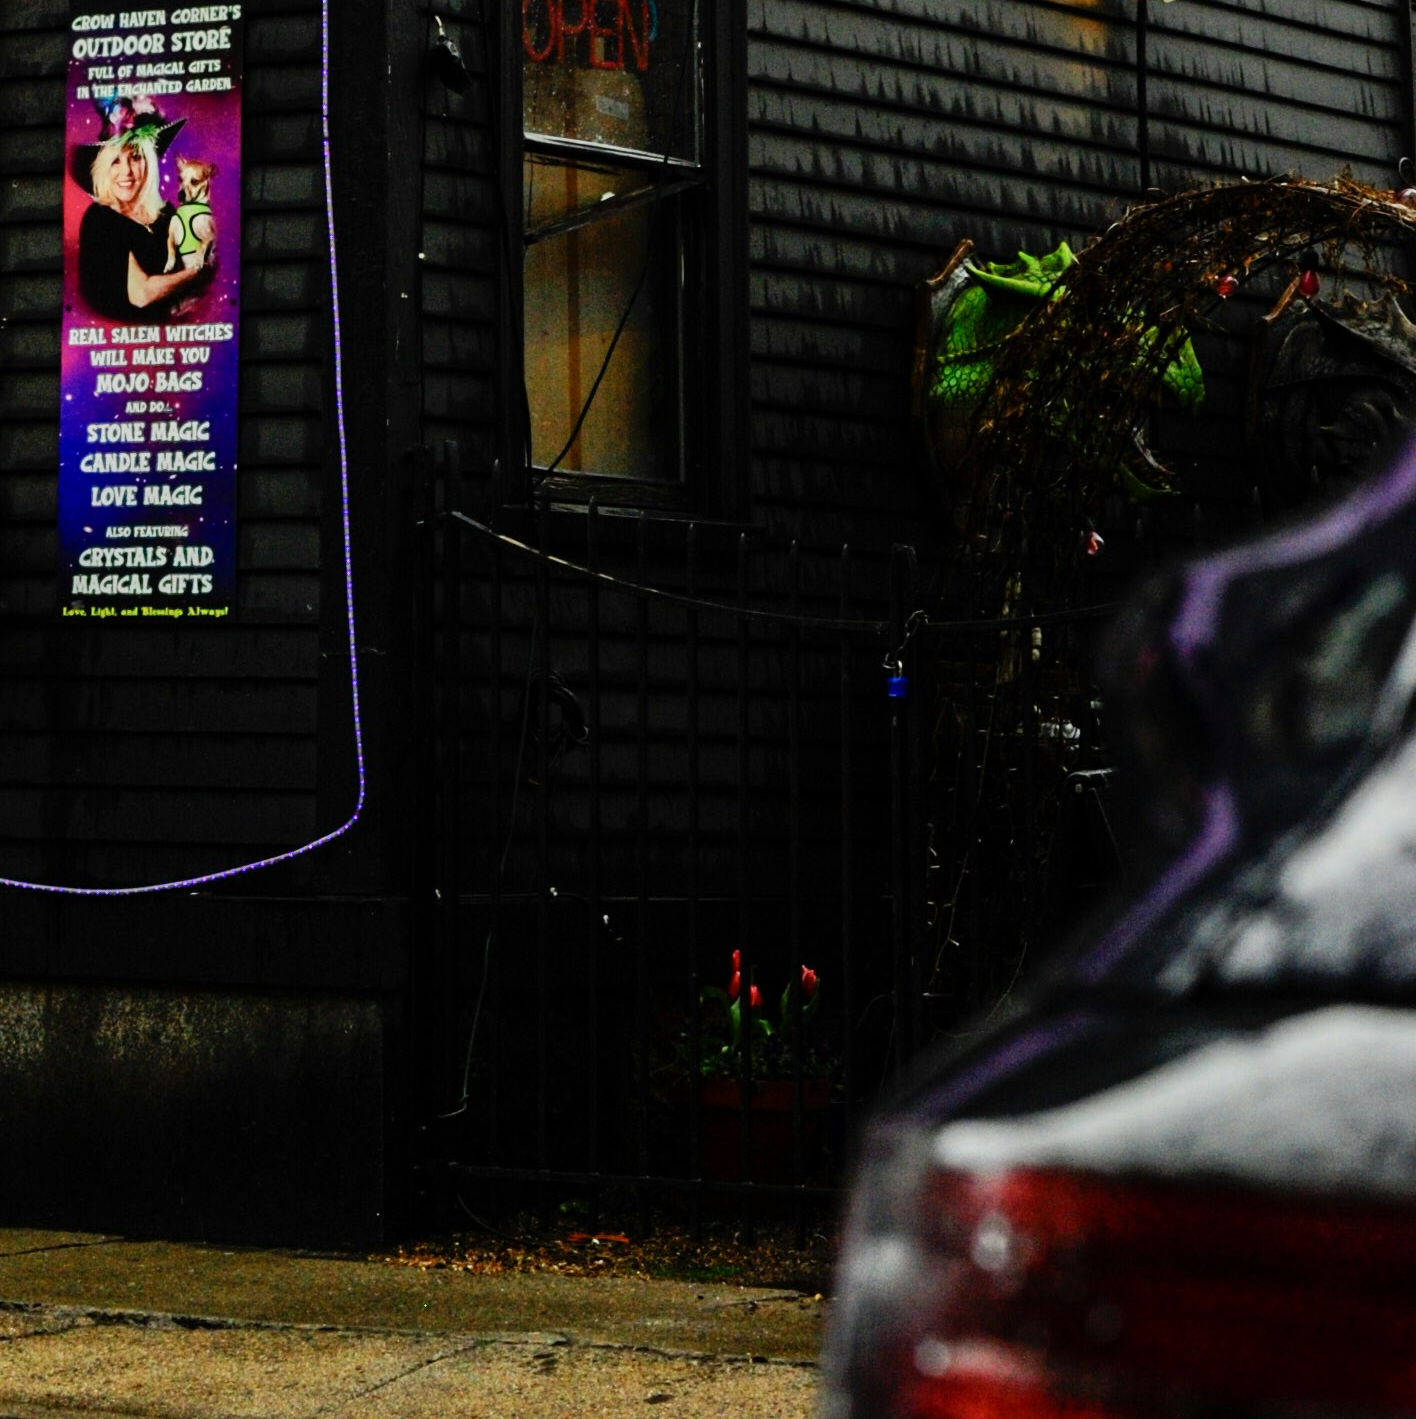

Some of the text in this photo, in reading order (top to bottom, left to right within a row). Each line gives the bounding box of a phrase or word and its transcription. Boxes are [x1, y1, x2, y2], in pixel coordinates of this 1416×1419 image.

[71, 4, 242, 32] CROW HAVEN CORNER'S
[72, 27, 232, 59] OUTDOOR STORE
[88, 59, 221, 80] FULL OF MAGICAL GIFTS
[76, 77, 232, 100] IN THE ENCHANTED GARDEN
[68, 323, 234, 345] REAL SALEM WITCHES
[90, 346, 211, 366] WILL MAKE YOU
[96, 370, 203, 393] MOJO BAGS
[125, 401, 147, 413] AND
[87, 420, 211, 443] STONE MAGIC
[80, 451, 216, 473] CANDLE MAGIC
[91, 484, 203, 507] LOVE MAGIC
[105, 524, 189, 538] ALSO FEATURING
[78, 545, 215, 568] CRYSTALS AND
[71, 573, 213, 595] MAGICAL GIFTS
[120, 607, 138, 617] and
[141, 606, 184, 619] Blessings
[187, 605, 229, 618] Always!
